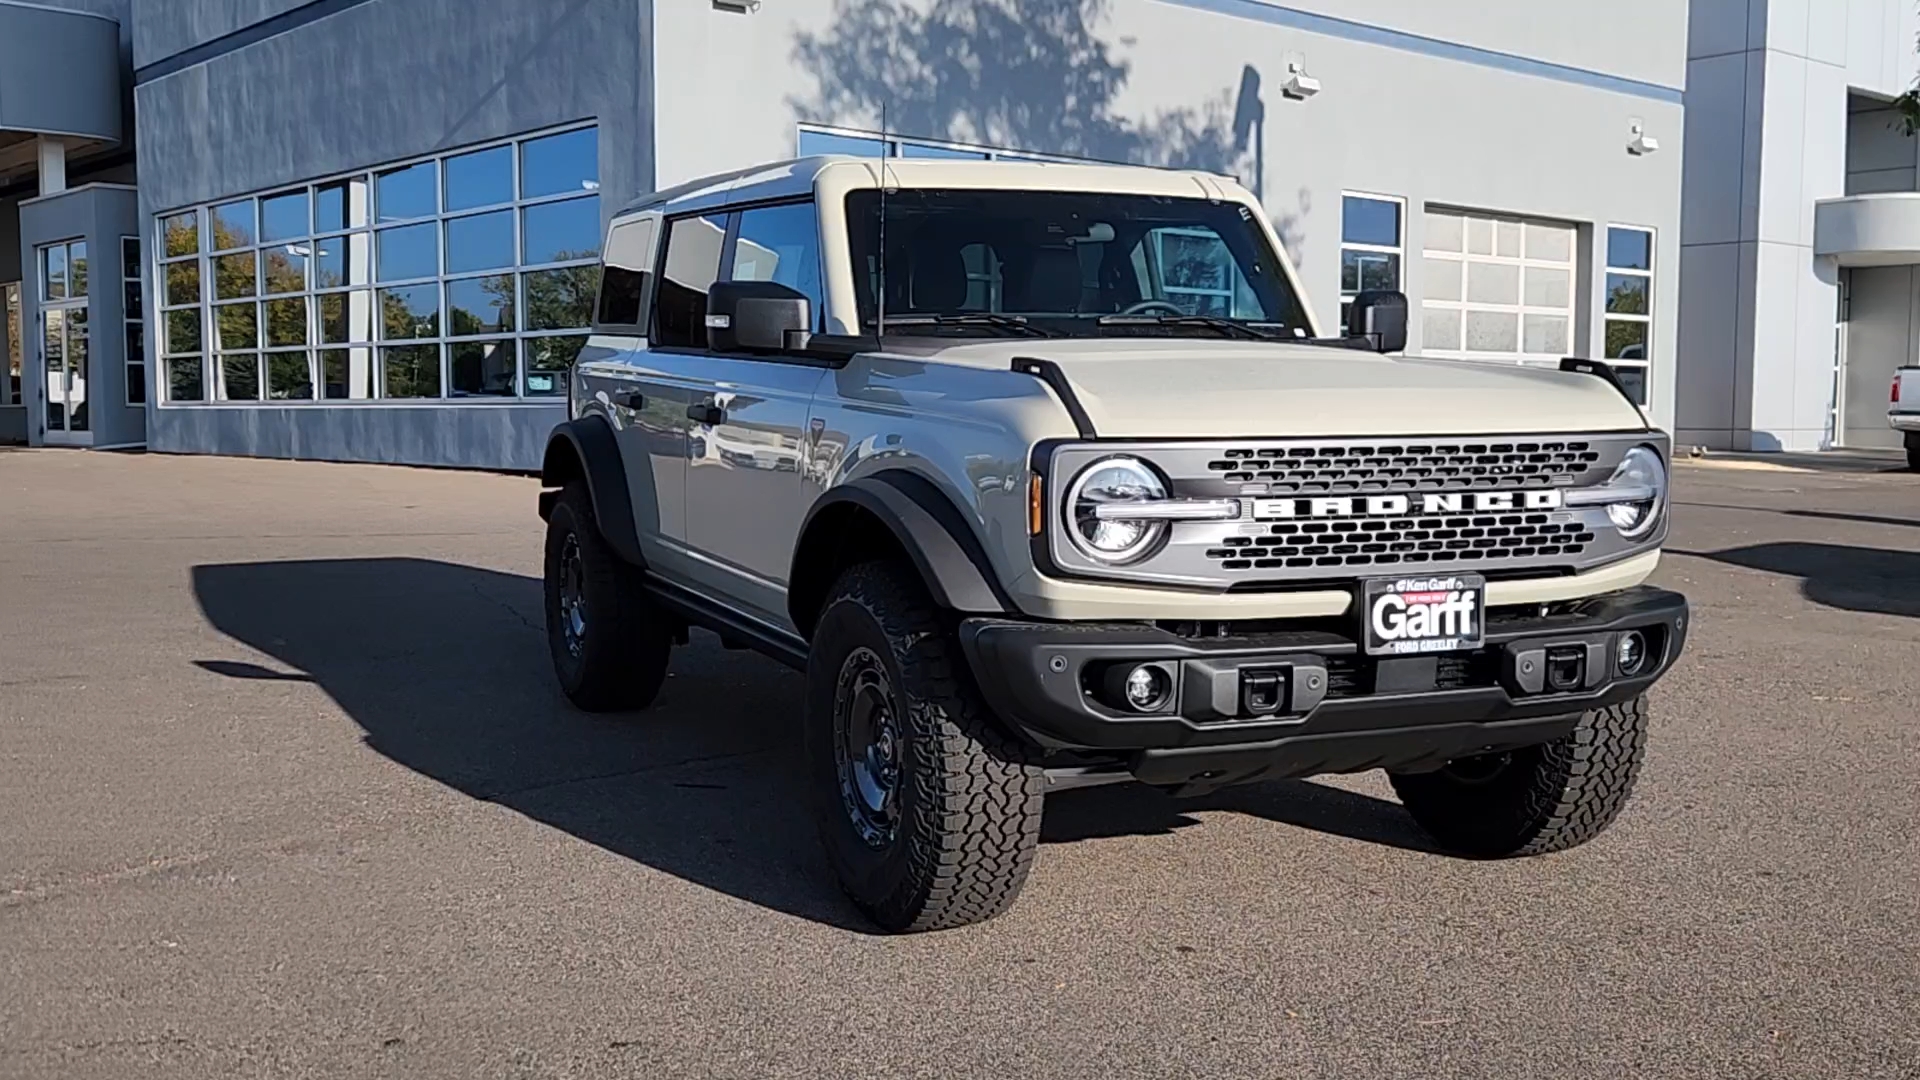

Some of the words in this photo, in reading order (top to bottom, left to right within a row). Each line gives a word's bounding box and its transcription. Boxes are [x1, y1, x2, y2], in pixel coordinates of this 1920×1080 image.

[1253, 489, 1561, 518] BRONCO
[1406, 579, 1427, 591] Ken
[1428, 577, 1457, 591] Garff
[1372, 590, 1475, 640] Garff
[1395, 641, 1418, 653] FORD
